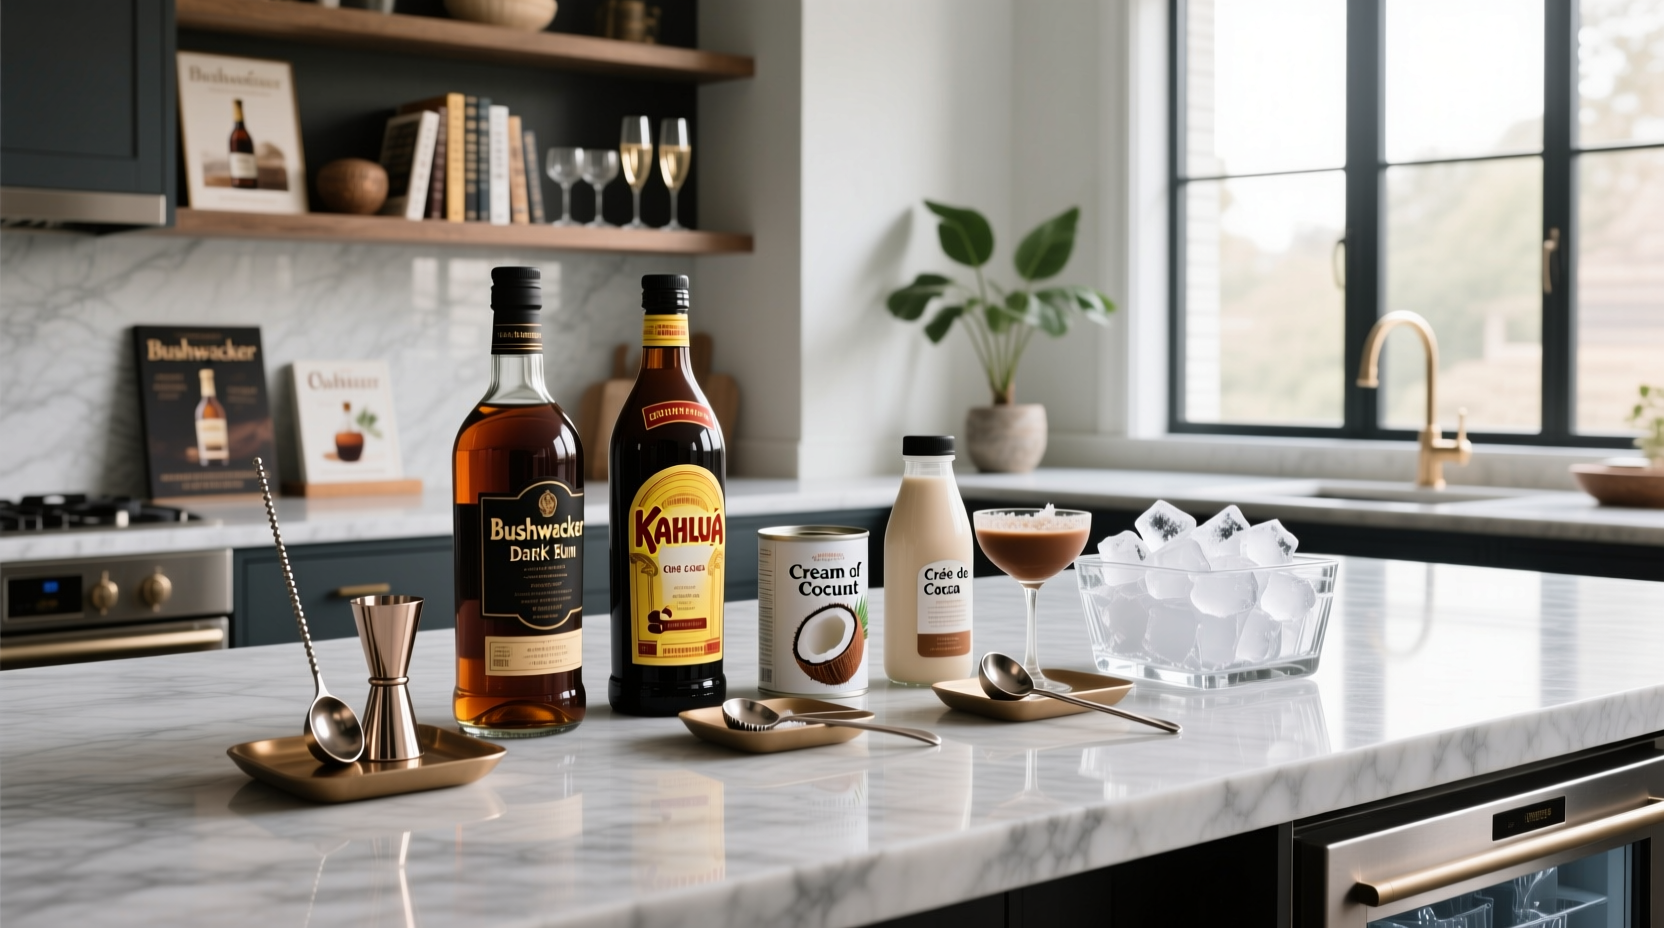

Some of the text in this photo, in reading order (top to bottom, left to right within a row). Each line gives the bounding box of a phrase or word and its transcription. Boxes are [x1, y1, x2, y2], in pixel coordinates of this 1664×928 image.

[147, 338, 257, 361] Bushwacker
[490, 515, 584, 541] Bushwacker
[789, 562, 862, 580] Cream of
[957, 566, 968, 578] de
[799, 580, 859, 596] Cocunt
